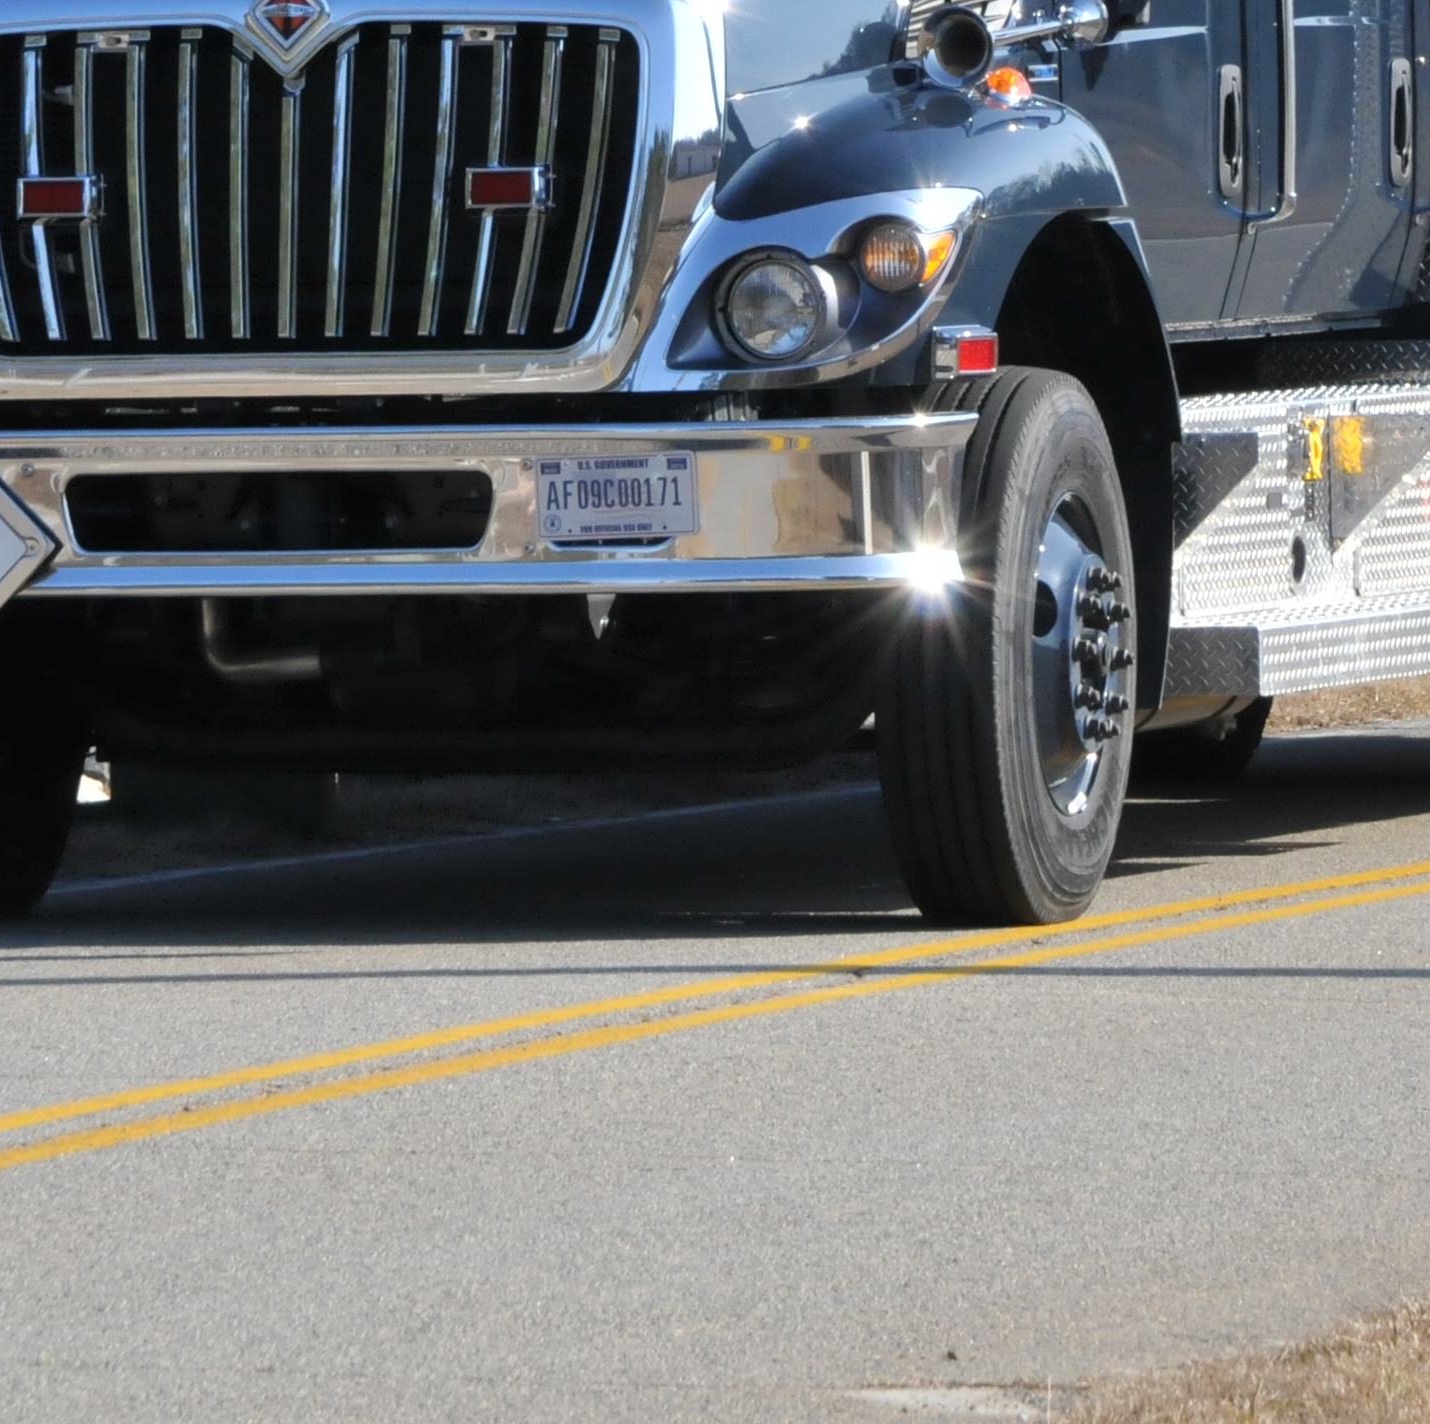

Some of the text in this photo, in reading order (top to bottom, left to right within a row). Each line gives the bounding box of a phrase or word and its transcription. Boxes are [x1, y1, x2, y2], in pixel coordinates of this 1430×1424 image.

[577, 458, 649, 470] U.S. GOVERNMENT
[546, 476, 682, 510] AF09C00171
